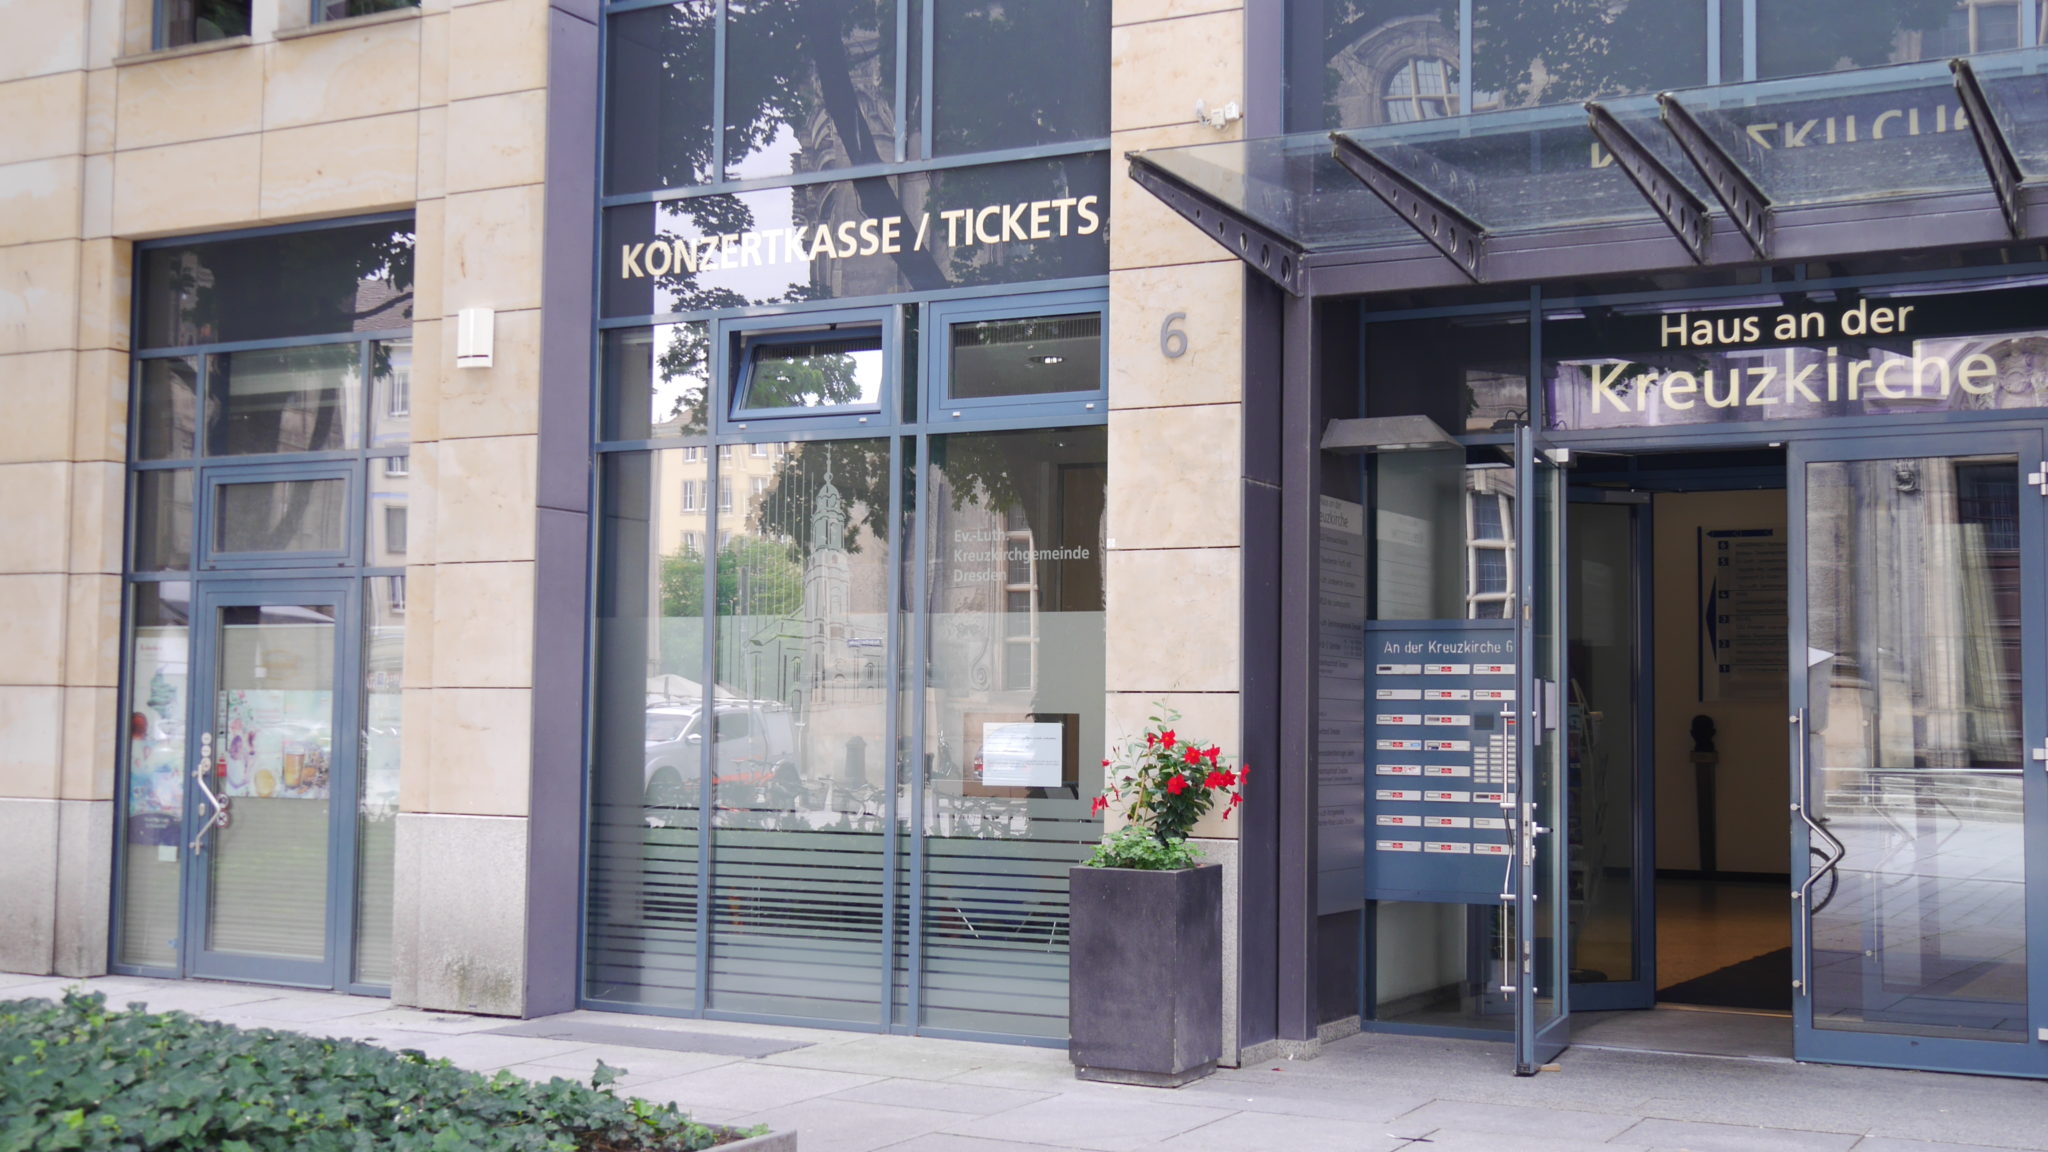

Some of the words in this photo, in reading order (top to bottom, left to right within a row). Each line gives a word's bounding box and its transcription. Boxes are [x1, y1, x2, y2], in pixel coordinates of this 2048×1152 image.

[621, 217, 901, 280] KONZERTKASSE
[940, 195, 1099, 249] TICKETS
[1159, 311, 1188, 359] 6
[1659, 313, 1760, 348] Haus
[1773, 311, 1825, 341] an
[1840, 297, 1915, 336] der
[1591, 338, 1997, 414] Kreuzkirche
[954, 529, 1010, 542] Ev.-Luth.
[953, 545, 1090, 564] Kreuzkirchgemeinde
[953, 568, 1007, 582] Dresden
[1384, 641, 1400, 654] An
[1404, 641, 1424, 654] der
[1428, 640, 1501, 654] Kreuzkirche
[1505, 640, 1513, 653] 6
